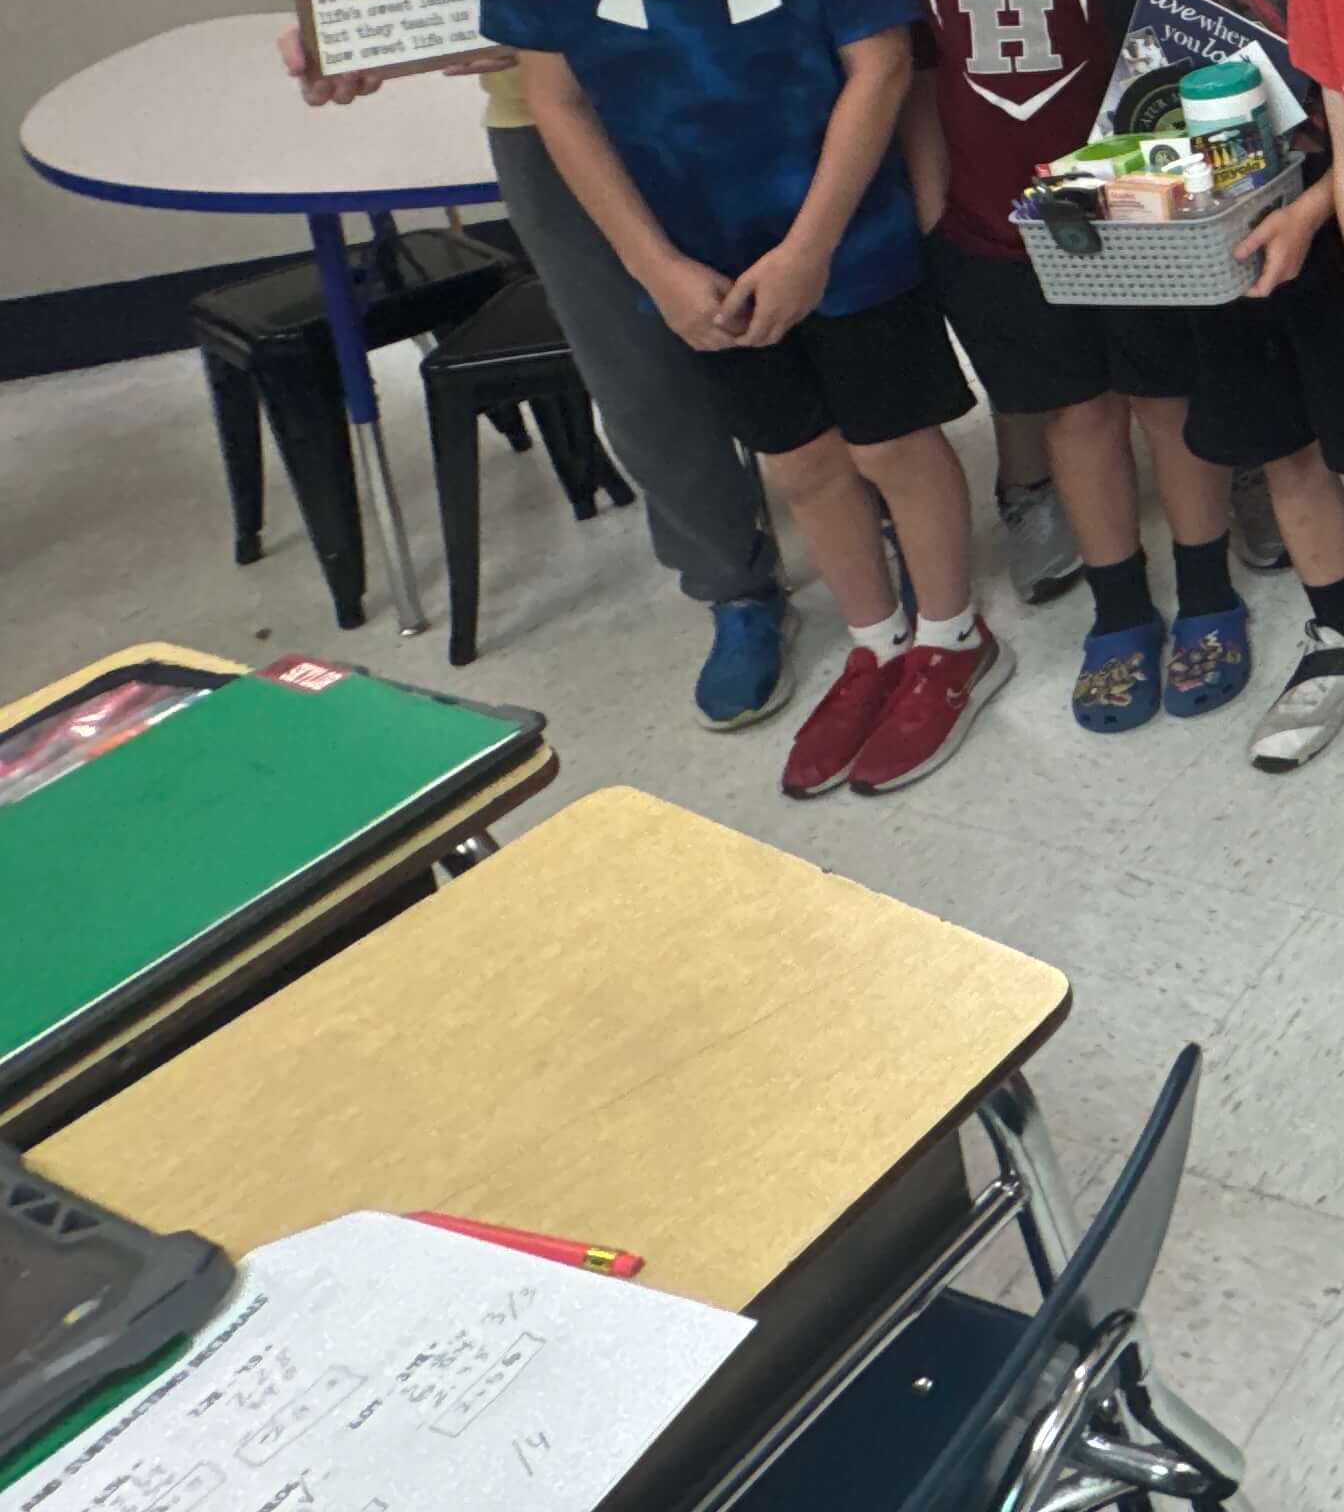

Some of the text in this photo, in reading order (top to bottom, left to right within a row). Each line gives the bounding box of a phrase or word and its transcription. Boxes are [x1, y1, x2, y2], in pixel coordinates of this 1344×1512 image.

[355, 23, 395, 39] they
[400, 13, 445, 31] teach
[450, 11, 470, 23] us
[1160, 24, 1203, 54] you
[1199, 15, 1252, 49] wher
[360, 40, 406, 59] sweet
[411, 32, 444, 50] life
